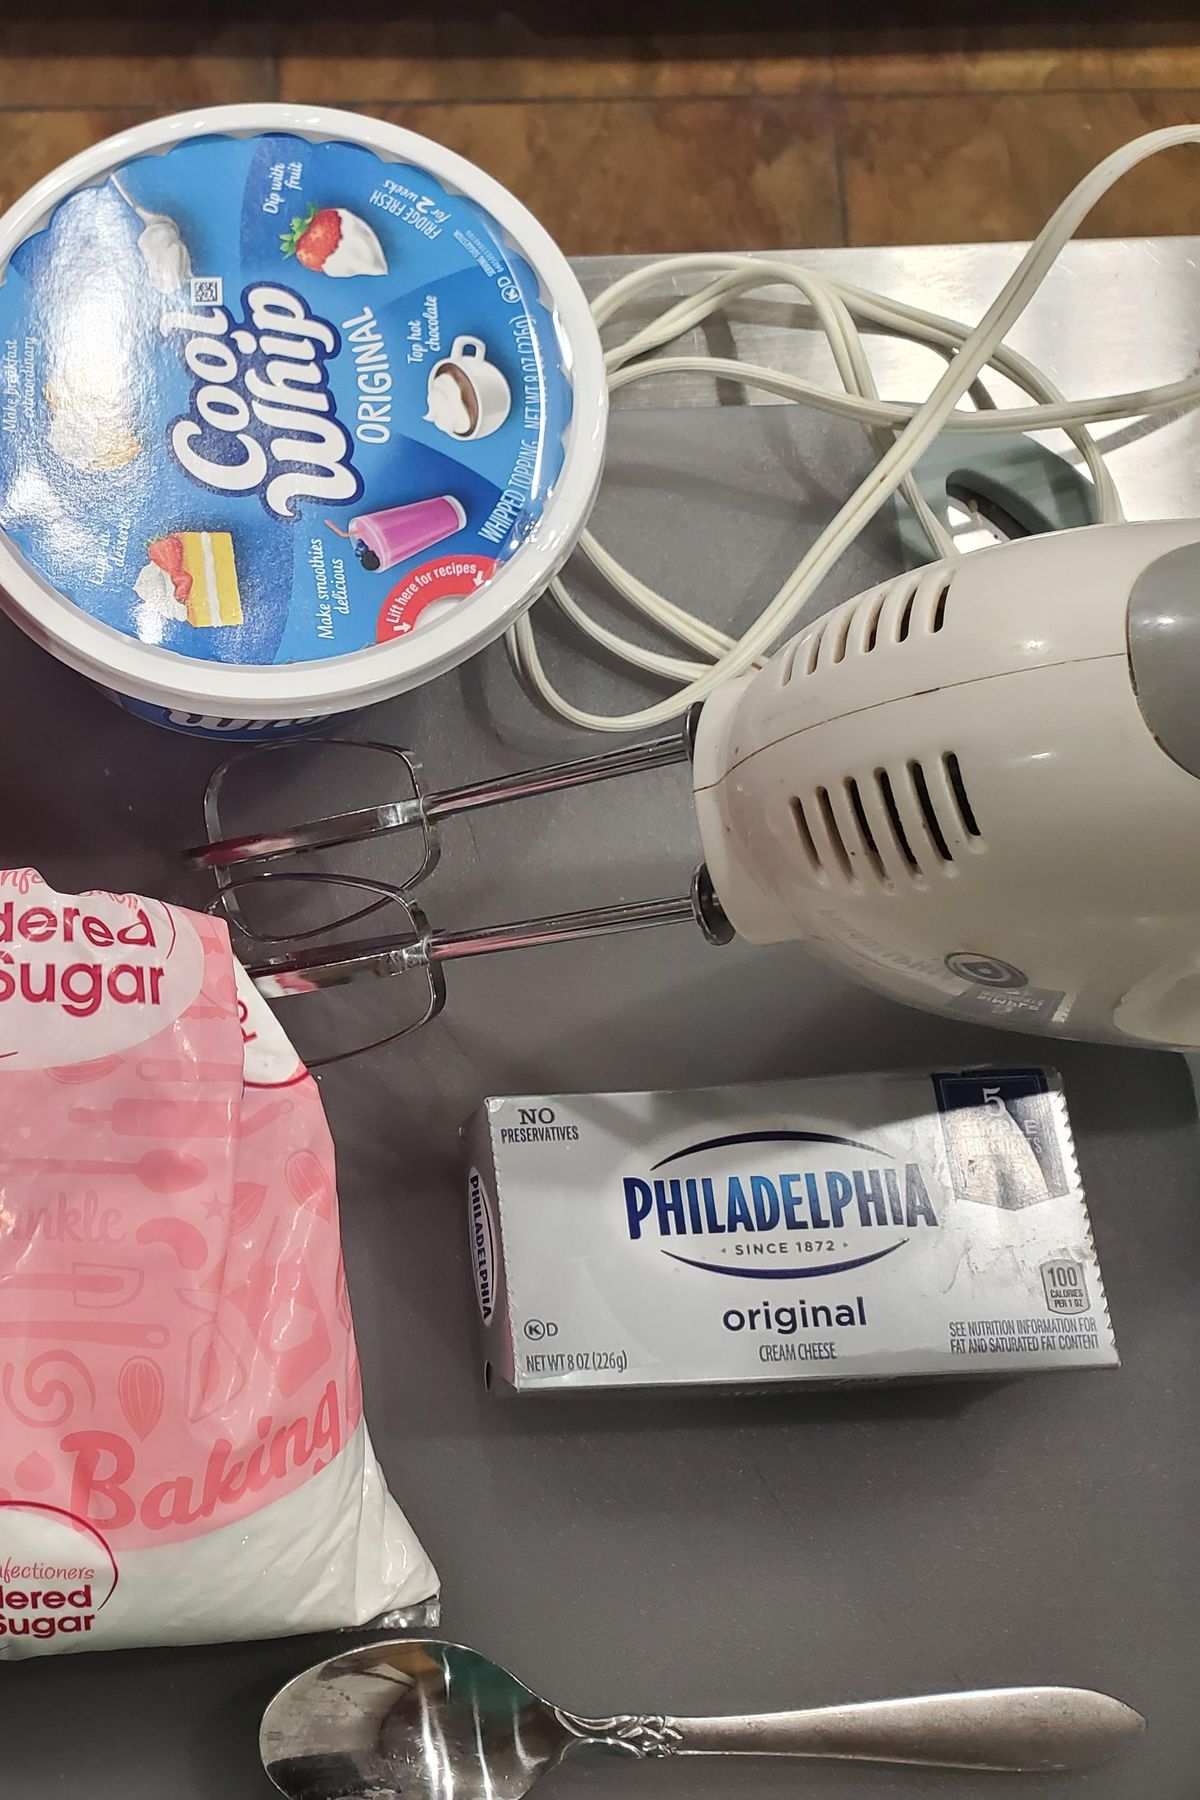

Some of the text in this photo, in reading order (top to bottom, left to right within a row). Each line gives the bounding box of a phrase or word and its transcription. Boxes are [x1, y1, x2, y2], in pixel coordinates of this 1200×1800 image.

[263, 162, 286, 215] Dip with
[284, 161, 303, 191] fruit
[368, 189, 443, 240] FRIDGE FRESH
[382, 179, 452, 223] for 2 weeks
[407, 319, 425, 364] Top hot
[422, 294, 441, 352] chocolate
[2, 339, 20, 433] Make breakfast
[342, 306, 393, 444] ORIGINAL
[524, 382, 546, 407] WT
[159, 307, 268, 491] Cool
[230, 286, 358, 517] Whip
[524, 408, 543, 430] NET
[508, 439, 539, 490] TOPPING
[478, 489, 526, 544] WHIPPED
[309, 538, 335, 640] Make smoothies
[330, 558, 350, 615] delicious
[386, 562, 477, 624] Lift here for recipes
[518, 1107, 555, 1125] NO
[982, 1087, 1006, 1116] 5
[500, 1125, 579, 1144] PRESERVATIVES
[623, 1163, 938, 1240] PHILADELPHIA
[470, 1175, 492, 1319] PHILADELPHIA
[735, 1240, 835, 1256] SINCE 1872
[1047, 1267, 1078, 1287] 100
[1050, 1289, 1083, 1298] CALORIES
[723, 1296, 867, 1335] original
[1054, 1299, 1066, 1308] PER
[1074, 1299, 1083, 1307] OZ
[949, 1317, 1097, 1337] SEE NUTRITION INFORMATION FOR
[950, 1334, 1099, 1354] FAT AND SATURATED FAT CONTENT
[525, 1350, 628, 1373] NET WT 8 OZ (226g)
[759, 1341, 837, 1363] CREAM CHEESE
[60, 1380, 341, 1531] Baking
